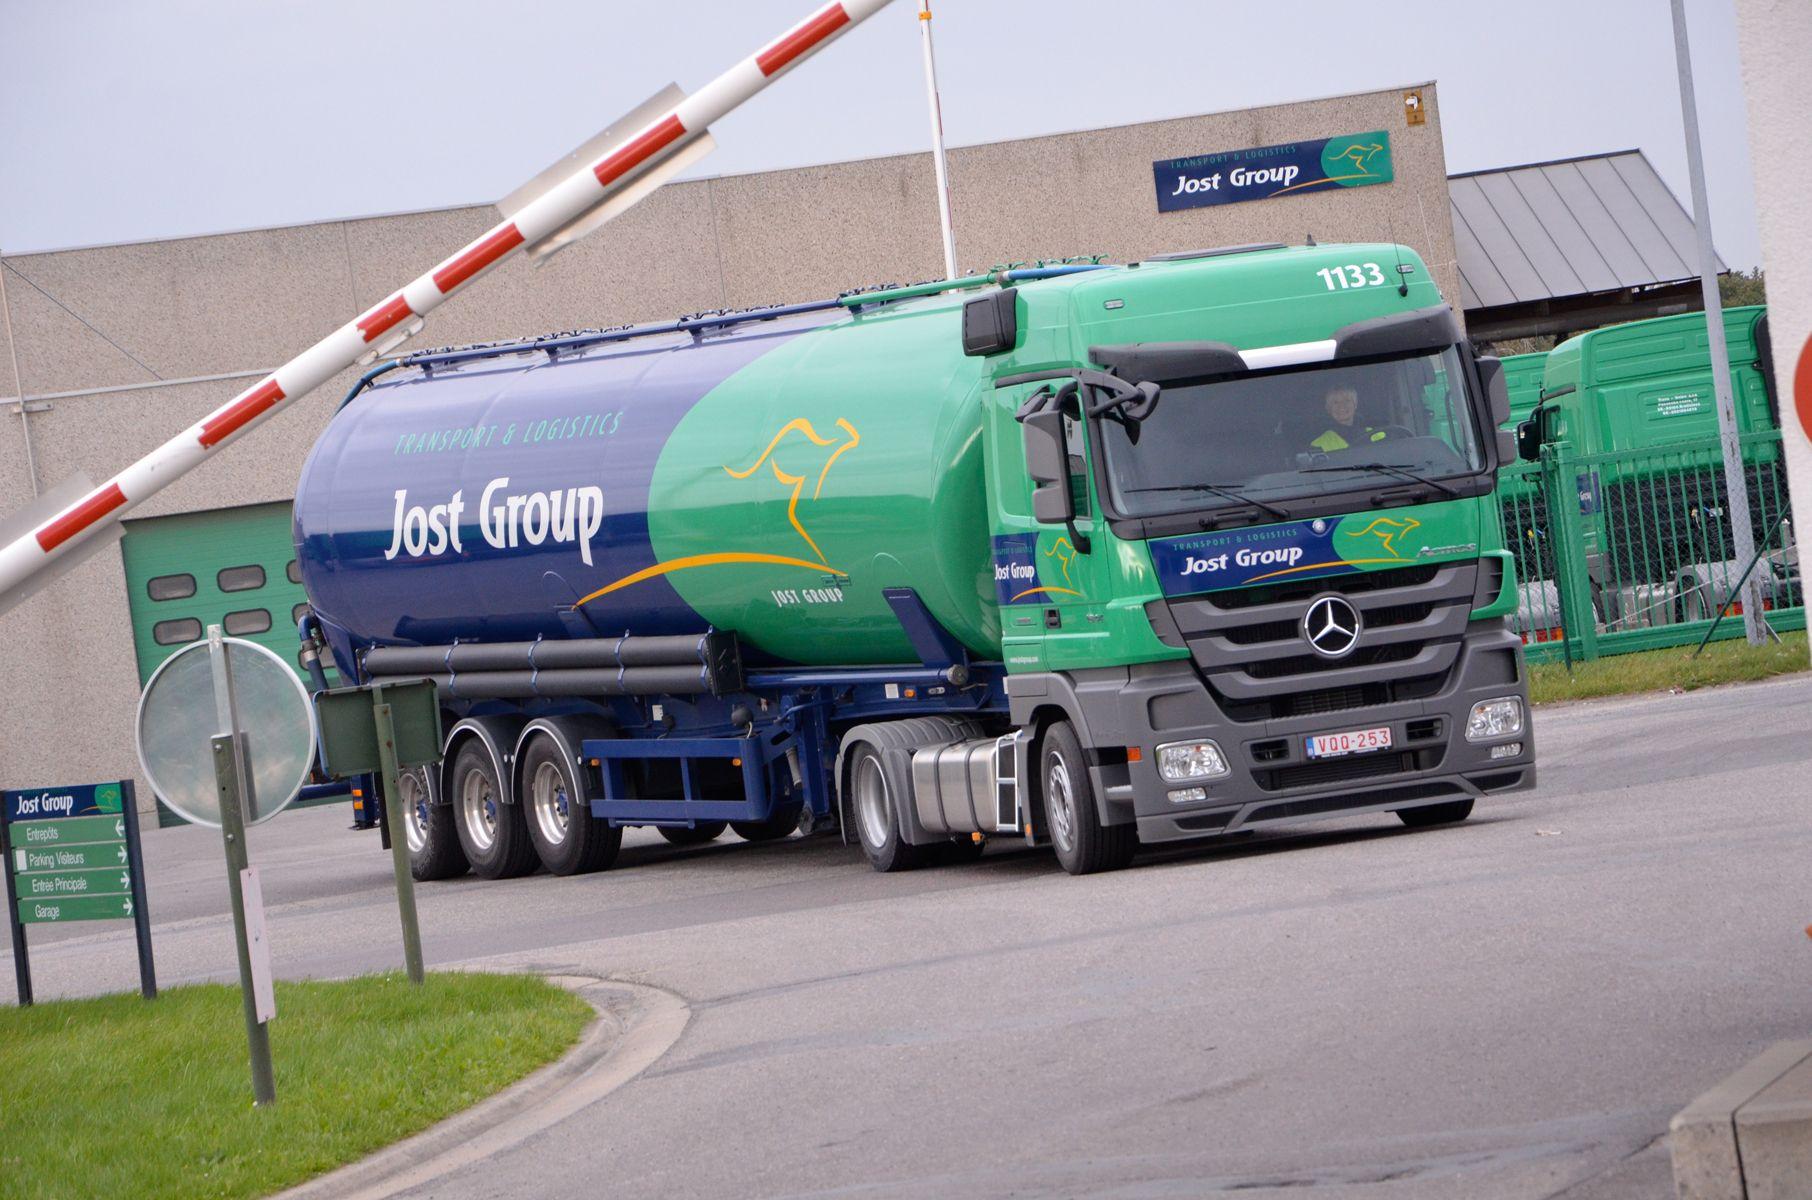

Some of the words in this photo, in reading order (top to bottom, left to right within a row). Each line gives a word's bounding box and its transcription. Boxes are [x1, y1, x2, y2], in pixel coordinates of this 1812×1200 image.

[1170, 154, 1229, 169] TRANSPORT
[1245, 145, 1297, 159] LOGISTICS
[1172, 172, 1222, 196] Jost
[1229, 165, 1299, 187] Group
[1316, 262, 1385, 291] 1133
[394, 424, 498, 456] TRANSPORT
[523, 411, 624, 443] LOGISTICS
[384, 488, 464, 561] Jost
[479, 476, 604, 567] Group
[1173, 536, 1231, 551] TRANSPORT
[1247, 528, 1298, 543] LOGISTICS
[994, 563, 1010, 581] Jost
[1010, 561, 1036, 584] Group
[1180, 553, 1229, 576] Jost
[1235, 546, 1304, 567] Group
[771, 589, 801, 608] JOST
[802, 587, 844, 604] GROUP
[16, 795, 40, 815] Jost
[41, 792, 74, 816] Group
[26, 826, 59, 843] Entrepôts
[28, 852, 55, 869] Parking
[55, 851, 85, 866] Visiteurs
[31, 878, 54, 893] Entrée
[54, 876, 88, 893] Principale
[34, 904, 60, 920] Garage
